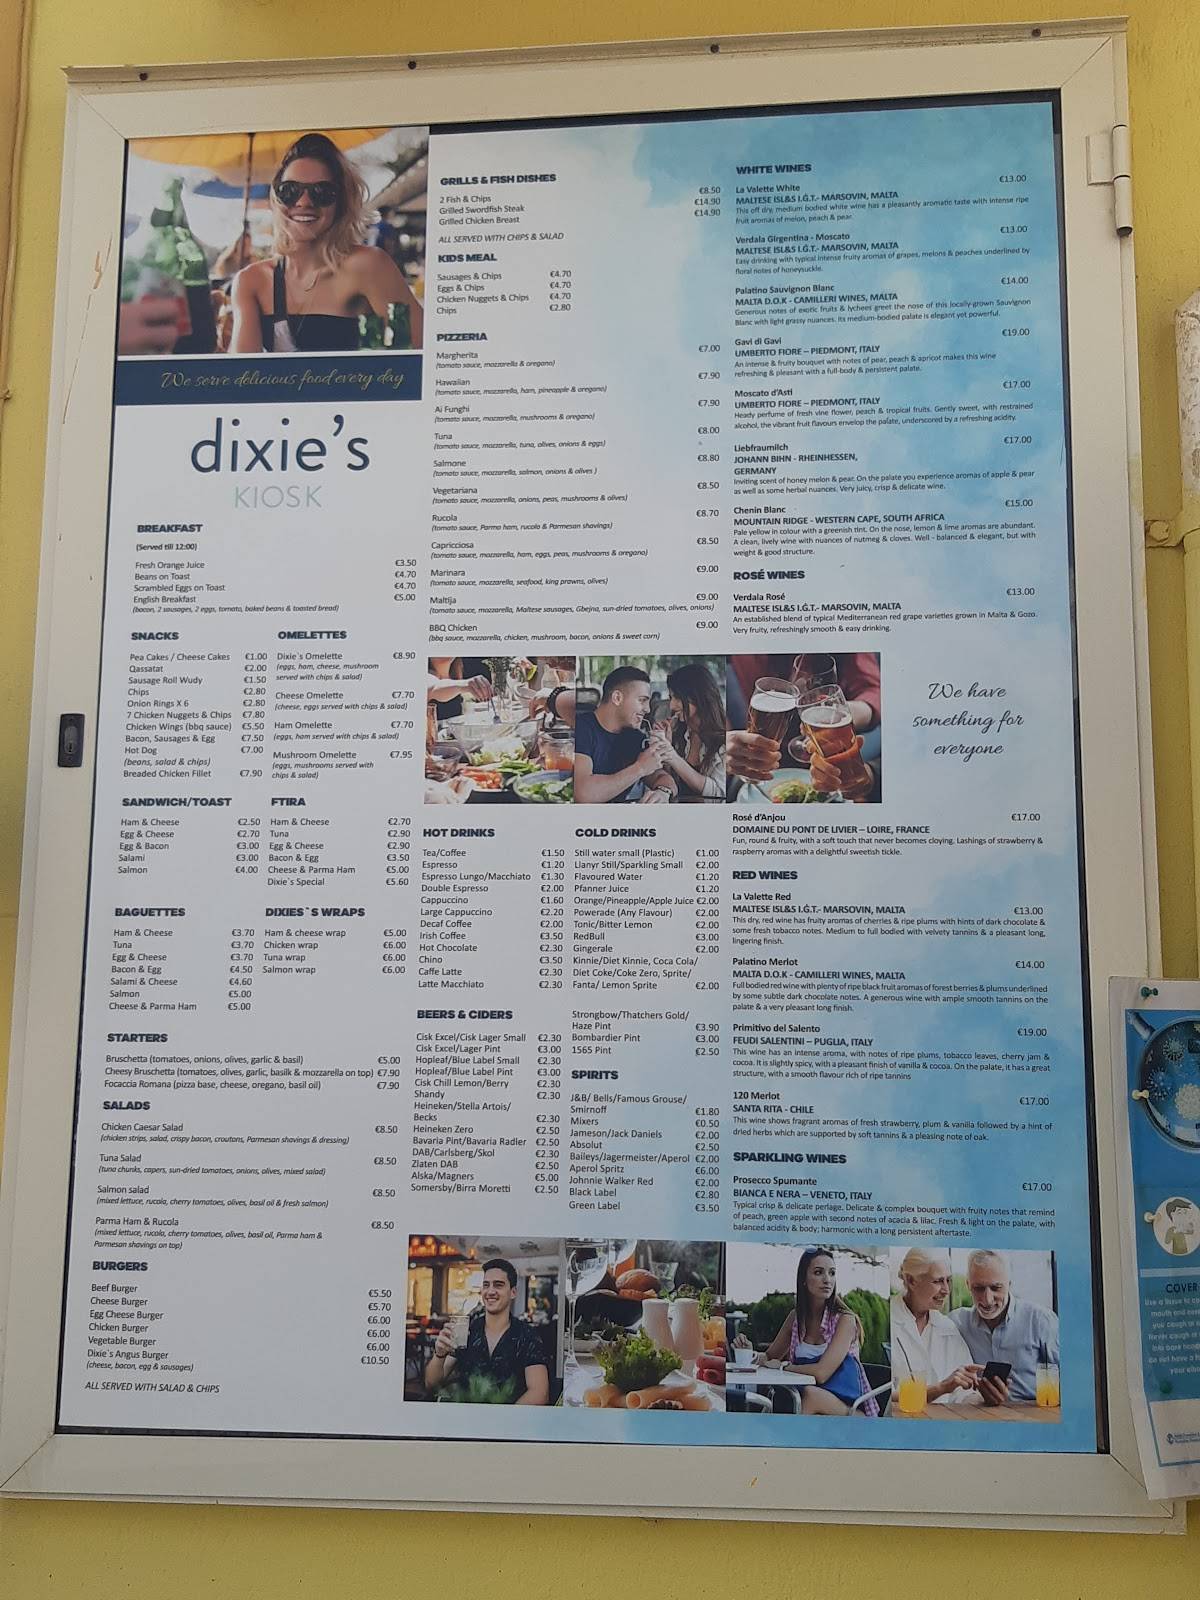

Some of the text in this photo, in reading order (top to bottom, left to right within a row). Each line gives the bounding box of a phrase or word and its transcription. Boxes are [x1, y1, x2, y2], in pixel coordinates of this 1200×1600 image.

[736, 163, 812, 175] WHITE WINES
[440, 173, 557, 186] GRILLS & FISH DISHES
[999, 174, 1027, 183] €13.00
[699, 186, 721, 194] €8.50
[736, 184, 800, 194] La Valette White
[439, 196, 445, 204] 2
[462, 195, 469, 203] &
[470, 194, 492, 204] Chips
[454, 235, 483, 243] SERVED
[484, 234, 505, 242] WITH
[507, 233, 529, 242] CHIPS
[530, 233, 537, 241] &
[539, 232, 564, 241] SALAD
[438, 253, 497, 263] KIDS MEAL
[436, 293, 529, 304] Chicken Nuggets & Chips
[549, 292, 571, 300] €4.70
[436, 332, 488, 342] PIZZERIA
[1002, 328, 1030, 337] €19.00
[734, 337, 782, 346] Gavi di Gavi
[698, 344, 721, 353] €7.00
[735, 349, 776, 357] UMBERTO
[778, 348, 802, 356] FIORE
[811, 346, 857, 355] PIEDMONT,
[859, 345, 880, 353] ITALY
[436, 351, 478, 361] Margherita
[161, 368, 405, 392] We serve delicious food every day
[191, 414, 371, 473] dixie's
[697, 481, 720, 490] €8.50
[432, 486, 478, 496] Vegetariana
[234, 485, 323, 508] KIOSK
[1005, 499, 1033, 508] €15.00
[733, 505, 786, 515] Chenin Blanc
[137, 524, 203, 533] BREAKFAST
[136, 543, 163, 552] (Served
[175, 543, 197, 551] 12:00)
[135, 561, 205, 571] Fresh Orange Juice
[395, 559, 417, 567] €3.50
[134, 573, 157, 581] Beans
[171, 572, 190, 580] Toast
[394, 570, 417, 578] €4.70
[733, 568, 805, 581] ROSÉ WINES
[133, 595, 196, 605] English Breakfast
[394, 593, 416, 602] €5.00
[429, 623, 478, 633] BBQ Chicken
[696, 621, 719, 629] €9.00
[131, 632, 179, 641] SNACKS
[278, 630, 347, 640] OMELETTES
[129, 665, 163, 673] Qassatat
[244, 664, 267, 672] €2.00
[275, 691, 344, 700] Cheese Omelette
[391, 691, 415, 699] €7.70
[928, 681, 1007, 700] We have
[127, 699, 189, 709] Onion Rings X 6
[243, 699, 266, 707] €2.80
[912, 710, 1024, 734] something for
[933, 744, 1004, 763] everyone
[122, 797, 232, 807] SANDWICH/TOAST
[271, 797, 306, 806] FTIRA
[732, 813, 752, 821] Rosé
[1011, 813, 1041, 821] €17.00
[423, 828, 495, 837] HOT DRINKS
[575, 828, 656, 837] COLD DRINKS
[117, 866, 148, 874] Salmon
[235, 865, 258, 874] €4.00
[574, 872, 643, 881] Flavoured Water
[695, 873, 720, 881] €1.20
[732, 870, 798, 880] RED WINES
[420, 896, 469, 905] Cappuccino
[540, 896, 564, 905] €1.60
[115, 907, 185, 917] BAGUETTES
[321, 907, 365, 917] WRAPS
[264, 940, 319, 950] Chicken wrap
[383, 941, 407, 949] €6.00
[417, 1009, 513, 1020] BEERS & CIDERS
[107, 1033, 168, 1043] STARTERS
[571, 1070, 619, 1080] SPIRITS
[733, 1091, 780, 1100] 120 Merlot
[103, 1101, 150, 1111] SALADS
[1019, 1096, 1050, 1106] €17.00
[413, 1124, 474, 1134] Heineken Zero
[536, 1126, 560, 1135] €2.50
[99, 1153, 142, 1163] Tuna Salad
[374, 1156, 397, 1166] €8.50
[733, 1151, 847, 1164] SPARKLING WINES
[733, 1175, 817, 1187] Prosecco Spumante
[569, 1187, 617, 1197] Black Label
[1022, 1182, 1052, 1192] €17.00
[695, 1190, 720, 1199] €2.80
[92, 1261, 148, 1272] BURGERS
[91, 1283, 138, 1295] Beef Burger
[1165, 1282, 1198, 1294] COVER
[368, 1289, 392, 1298] €5.50
[85, 1381, 220, 1394] ALL SERVED WITH SALAD & CHIPS
